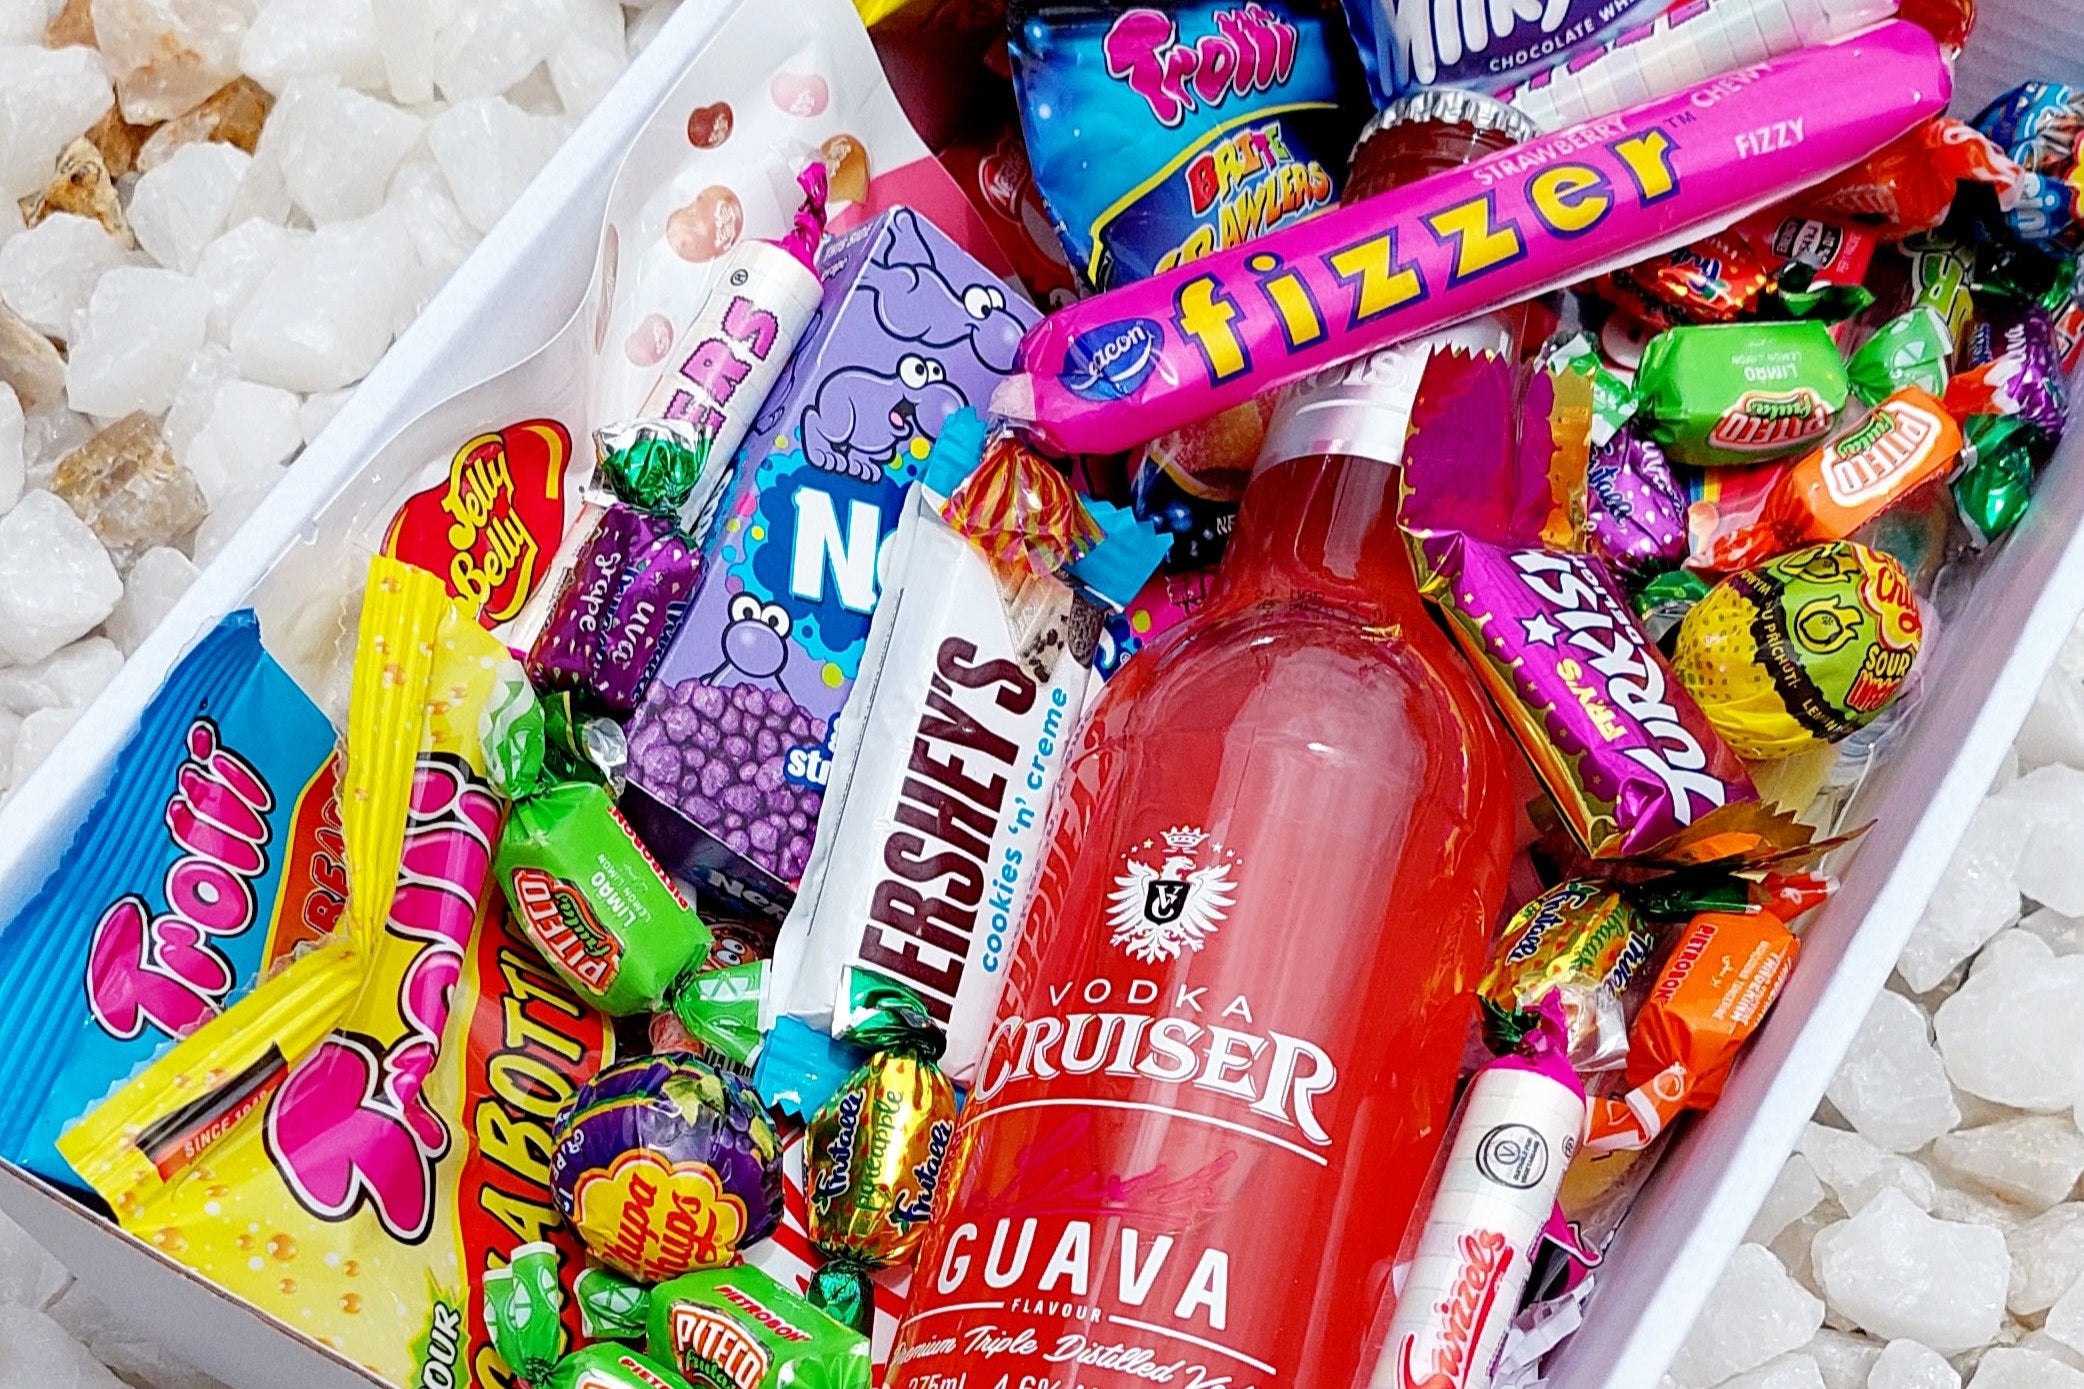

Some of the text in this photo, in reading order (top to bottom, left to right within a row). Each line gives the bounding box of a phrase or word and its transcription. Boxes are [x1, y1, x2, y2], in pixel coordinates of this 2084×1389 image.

[1104, 3, 1298, 127] Trolli
[1489, 18, 1596, 73] CHOCOLATE
[1472, 60, 1774, 186] STRAWBERRY CHEWY
[1733, 116, 1806, 160] FIZZY
[1187, 120, 1293, 217] BRITE
[1174, 125, 1680, 386] fizzer
[1722, 404, 1832, 444] PITECO
[1832, 410, 1930, 493] PITECO
[441, 434, 515, 551] Jelly
[448, 508, 539, 622] Belly
[579, 552, 622, 633] grape
[612, 601, 656, 665] uva
[1865, 647, 1911, 677] SOUR
[1556, 657, 1629, 743] FRY'S
[596, 853, 625, 887] LIMON
[982, 847, 1024, 974] cookies
[1026, 686, 1068, 792] creme
[86, 717, 272, 1041] Trolli
[623, 886, 653, 924] LEMON
[522, 879, 608, 985] PITECO
[555, 891, 611, 957] frutas
[1049, 978, 1253, 1023] VODKA
[1652, 923, 1718, 1008] PIETROBON
[474, 912, 586, 1195] BOTTL
[974, 1012, 1338, 1147] CRUISER
[184, 1118, 230, 1159] SINCE
[552, 1127, 585, 1180] GRPE
[712, 1284, 814, 1343] PIETROBON
[937, 1216, 1230, 1330] GUAVA
[1011, 1298, 1103, 1324] FLAVOUR
[418, 1300, 462, 1389] OUR
[675, 1312, 765, 1387] PITECO
[893, 1333, 956, 1368] Premium
[964, 1325, 1038, 1356] Triple
[1042, 1334, 1184, 1382] Distilled
